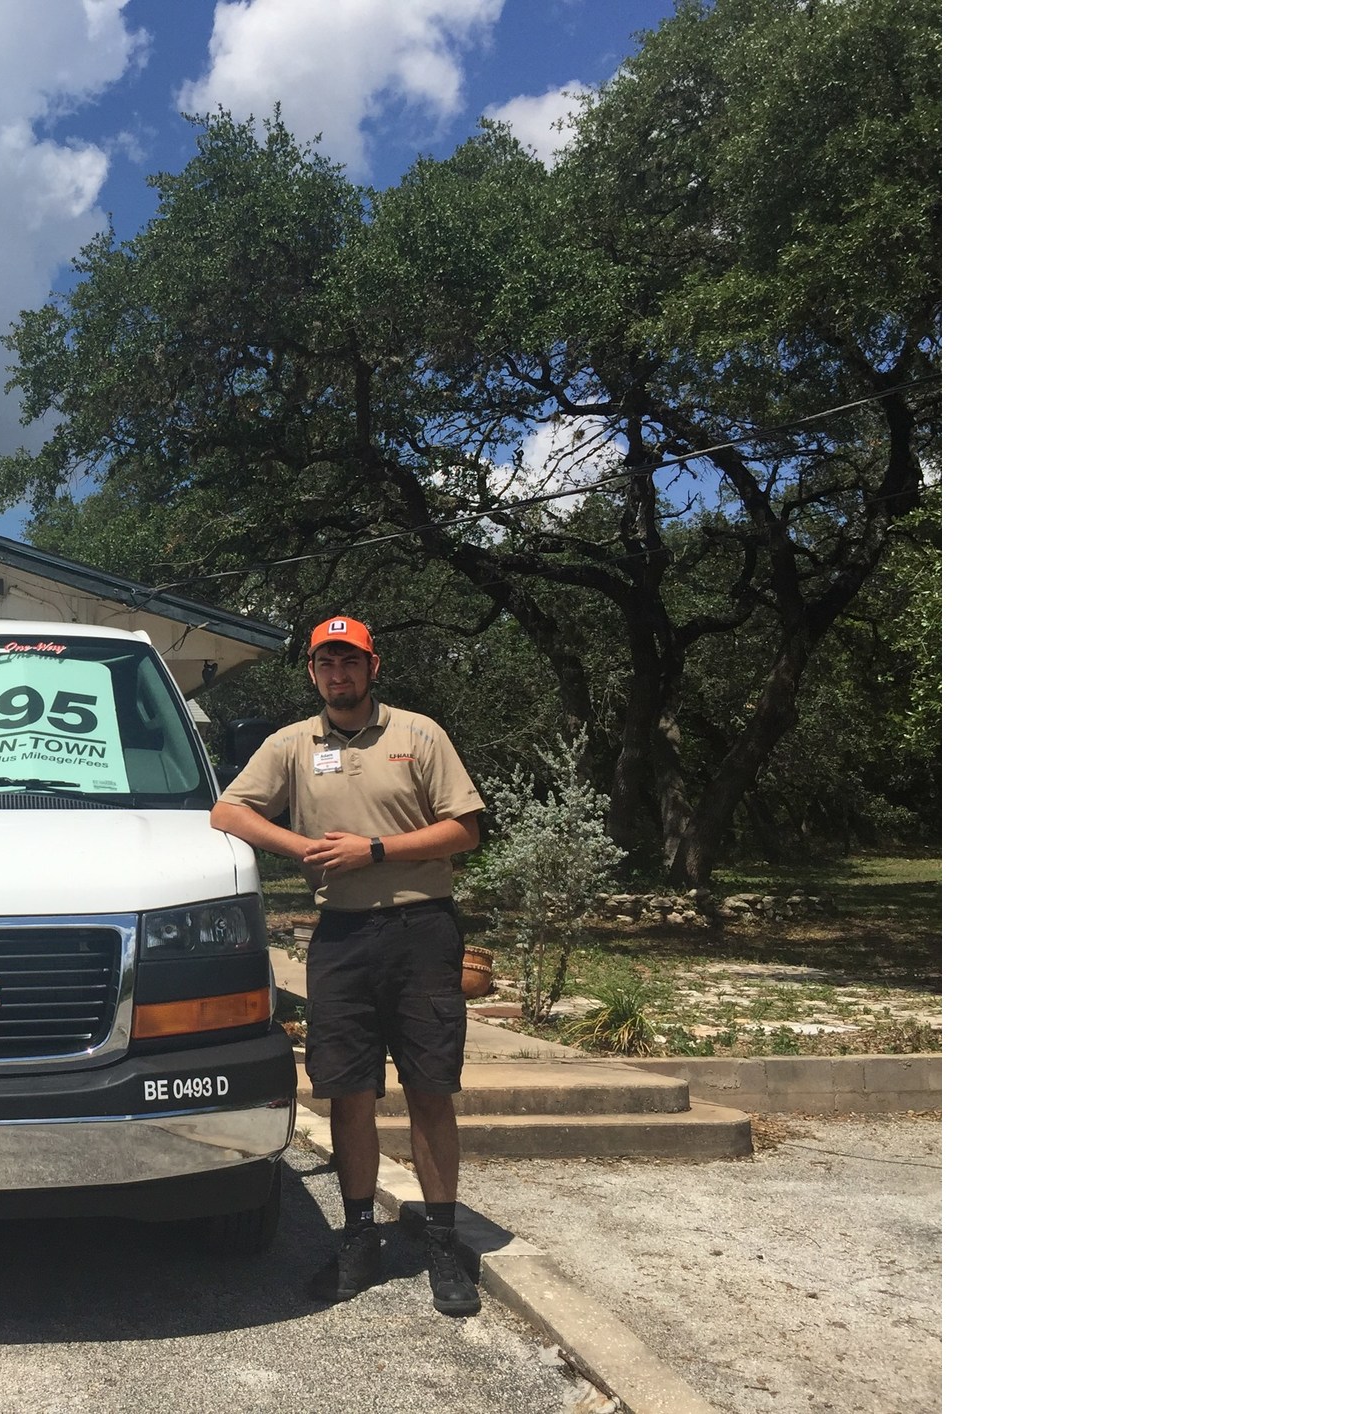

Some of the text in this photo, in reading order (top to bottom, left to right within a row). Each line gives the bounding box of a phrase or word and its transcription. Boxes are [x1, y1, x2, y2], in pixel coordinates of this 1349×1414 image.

[4, 641, 67, 655] One-Way
[21, 751, 109, 768] Mileage/Fees
[144, 1076, 229, 1101] BE 0493 D
